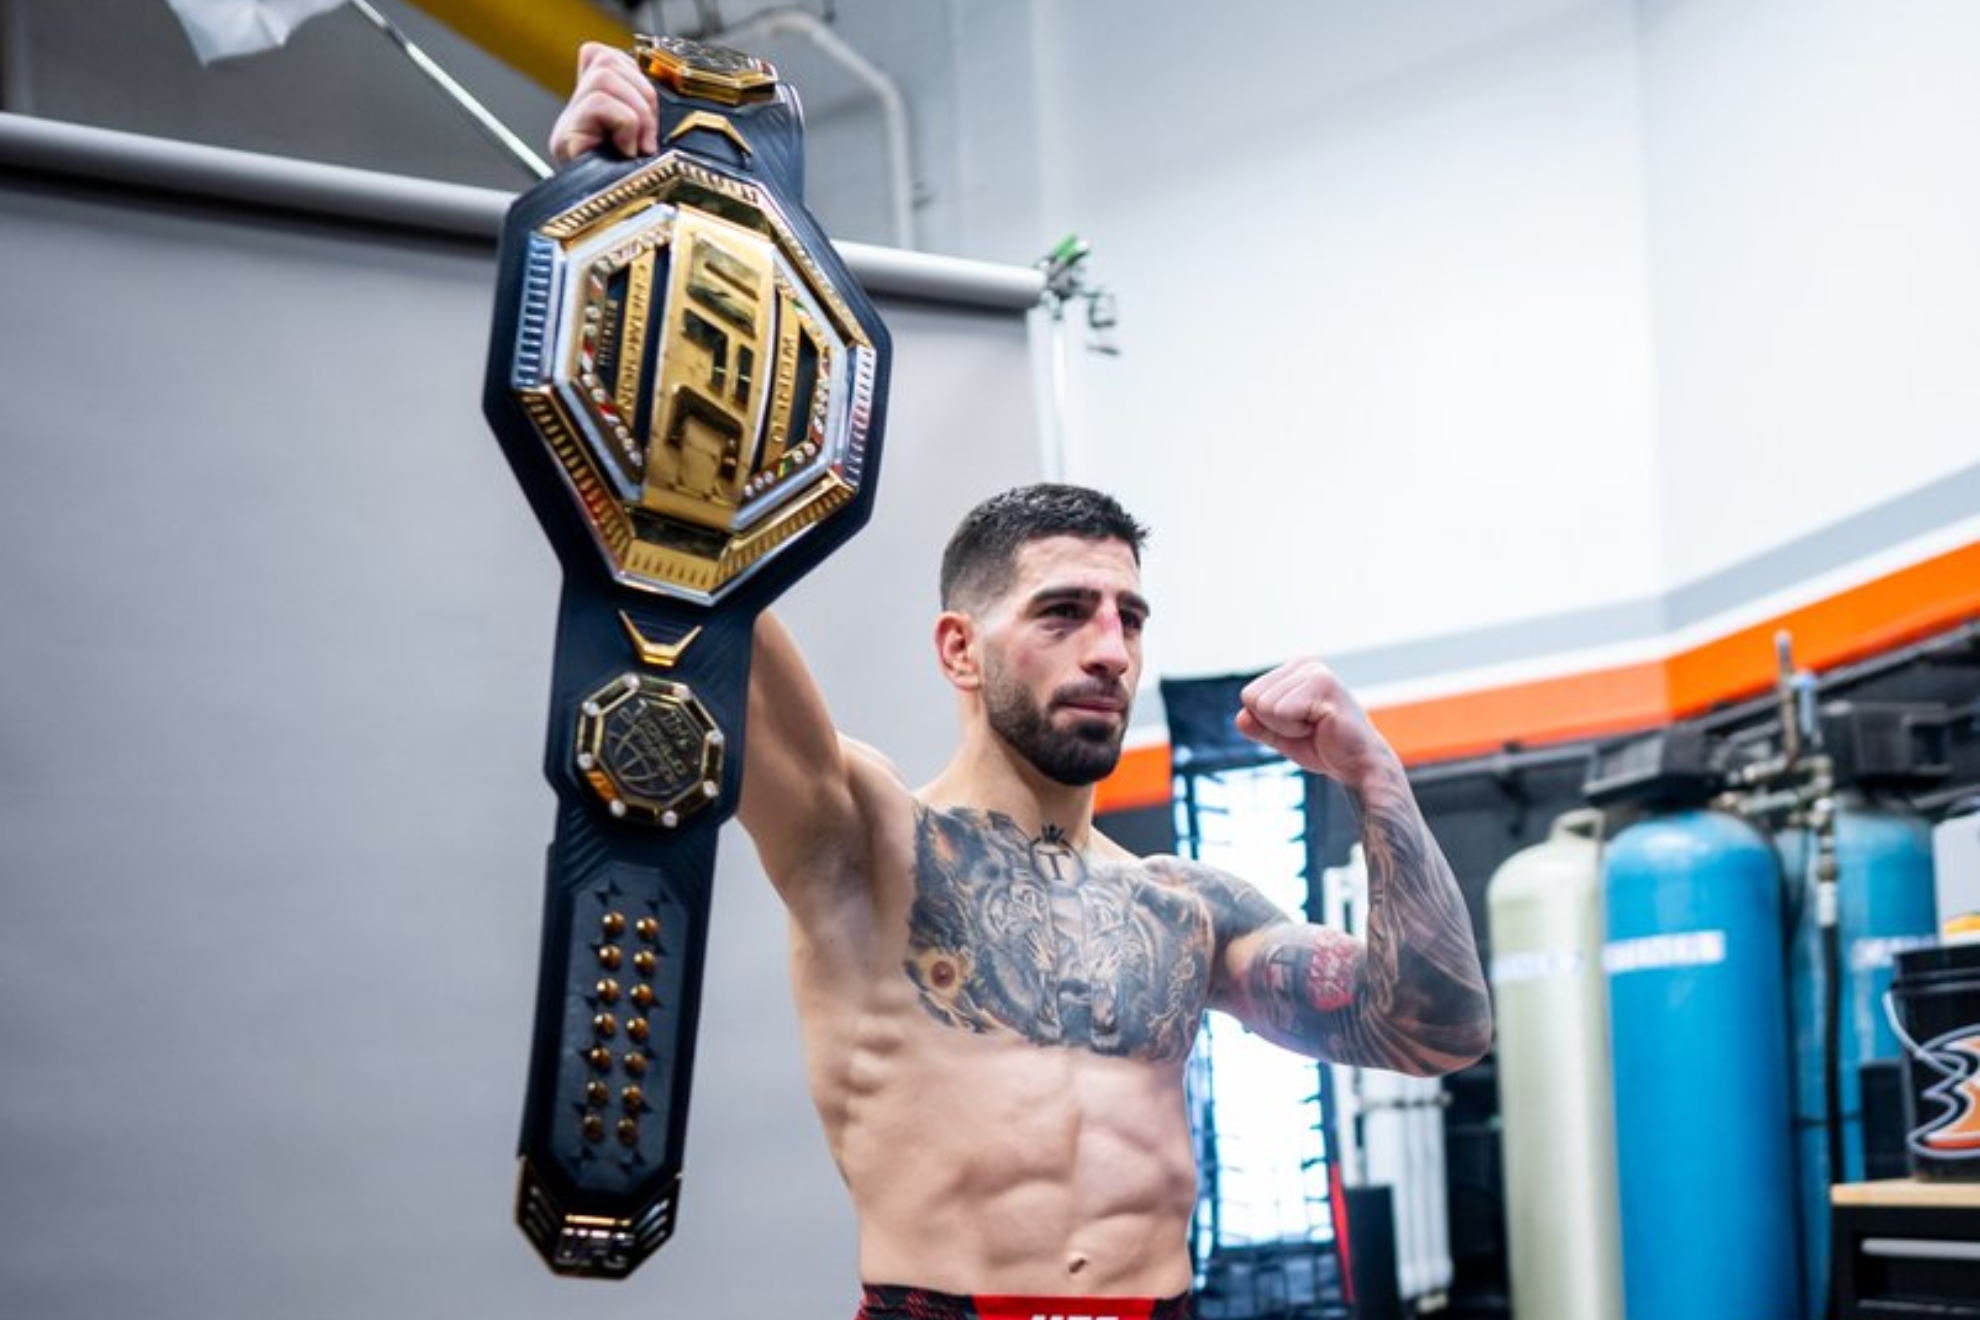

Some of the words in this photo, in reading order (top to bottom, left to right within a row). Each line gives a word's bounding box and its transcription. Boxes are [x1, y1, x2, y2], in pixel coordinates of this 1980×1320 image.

[617, 261, 649, 413] CHAMPION
[666, 236, 763, 486] UFC
[771, 335, 798, 443] WORLD
[1036, 848, 1073, 881] T
